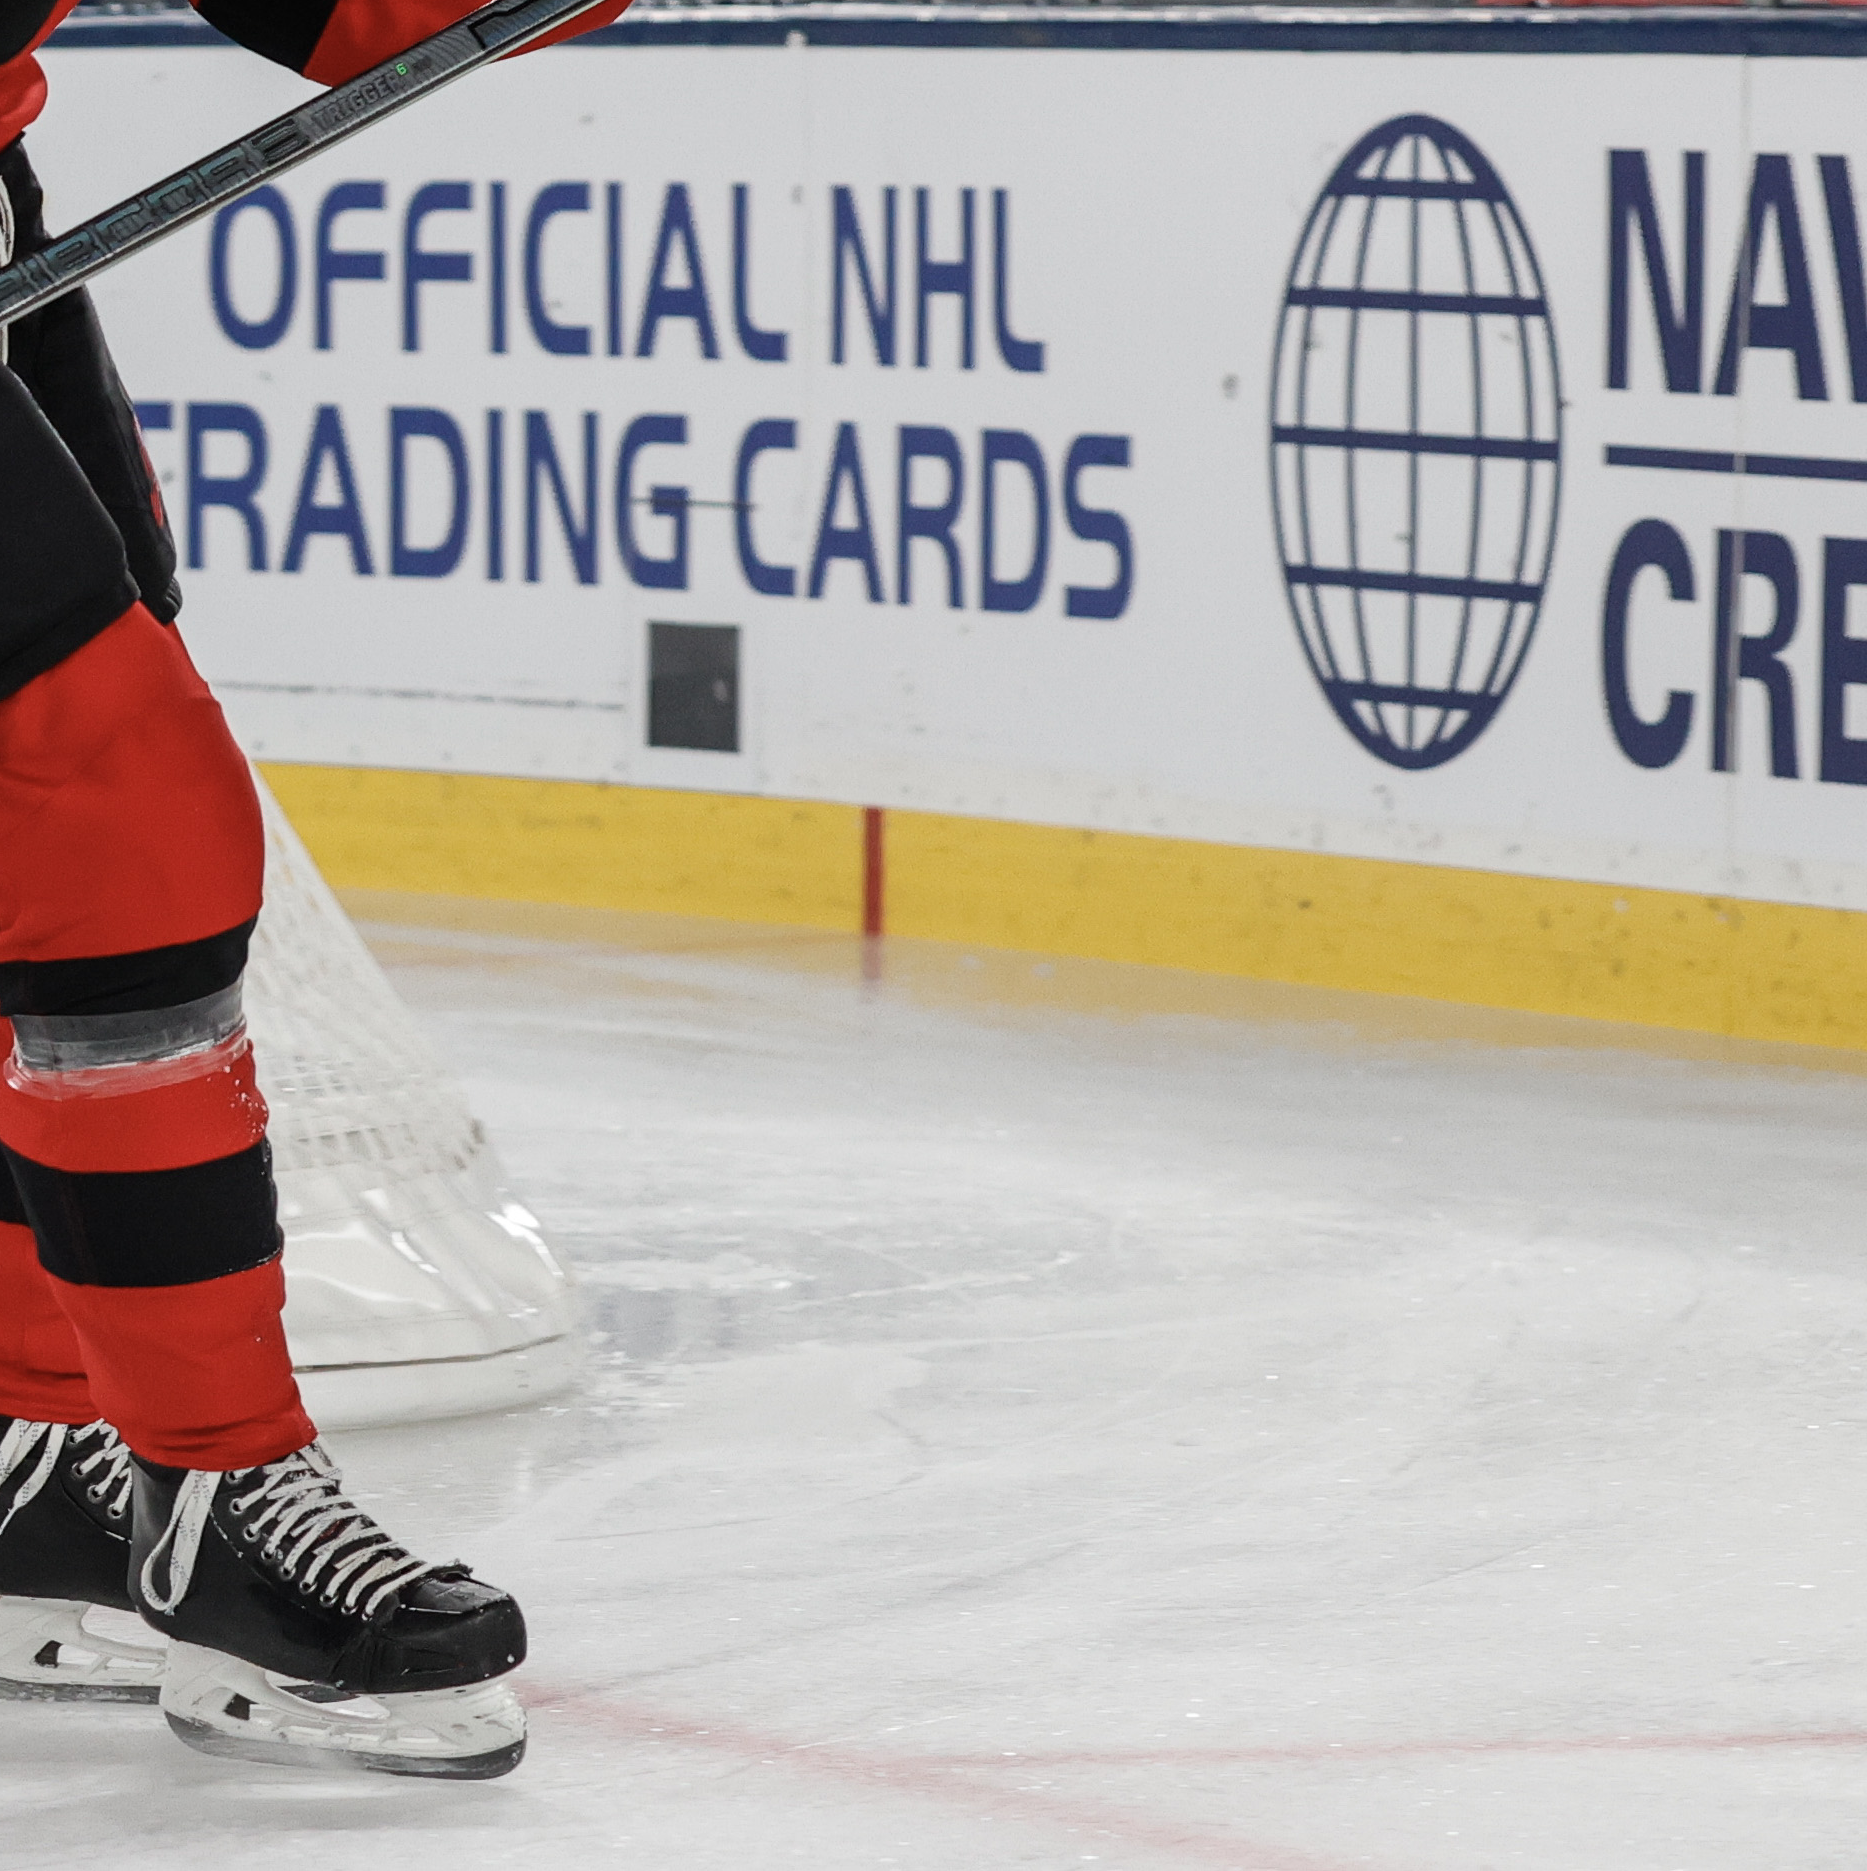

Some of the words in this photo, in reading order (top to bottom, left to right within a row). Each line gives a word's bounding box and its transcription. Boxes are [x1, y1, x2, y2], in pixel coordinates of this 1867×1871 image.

[208, 179, 788, 363] OFFICIAL
[831, 185, 1045, 374] NHL
[133, 399, 691, 592] RADING
[734, 417, 1135, 622] CARDS
